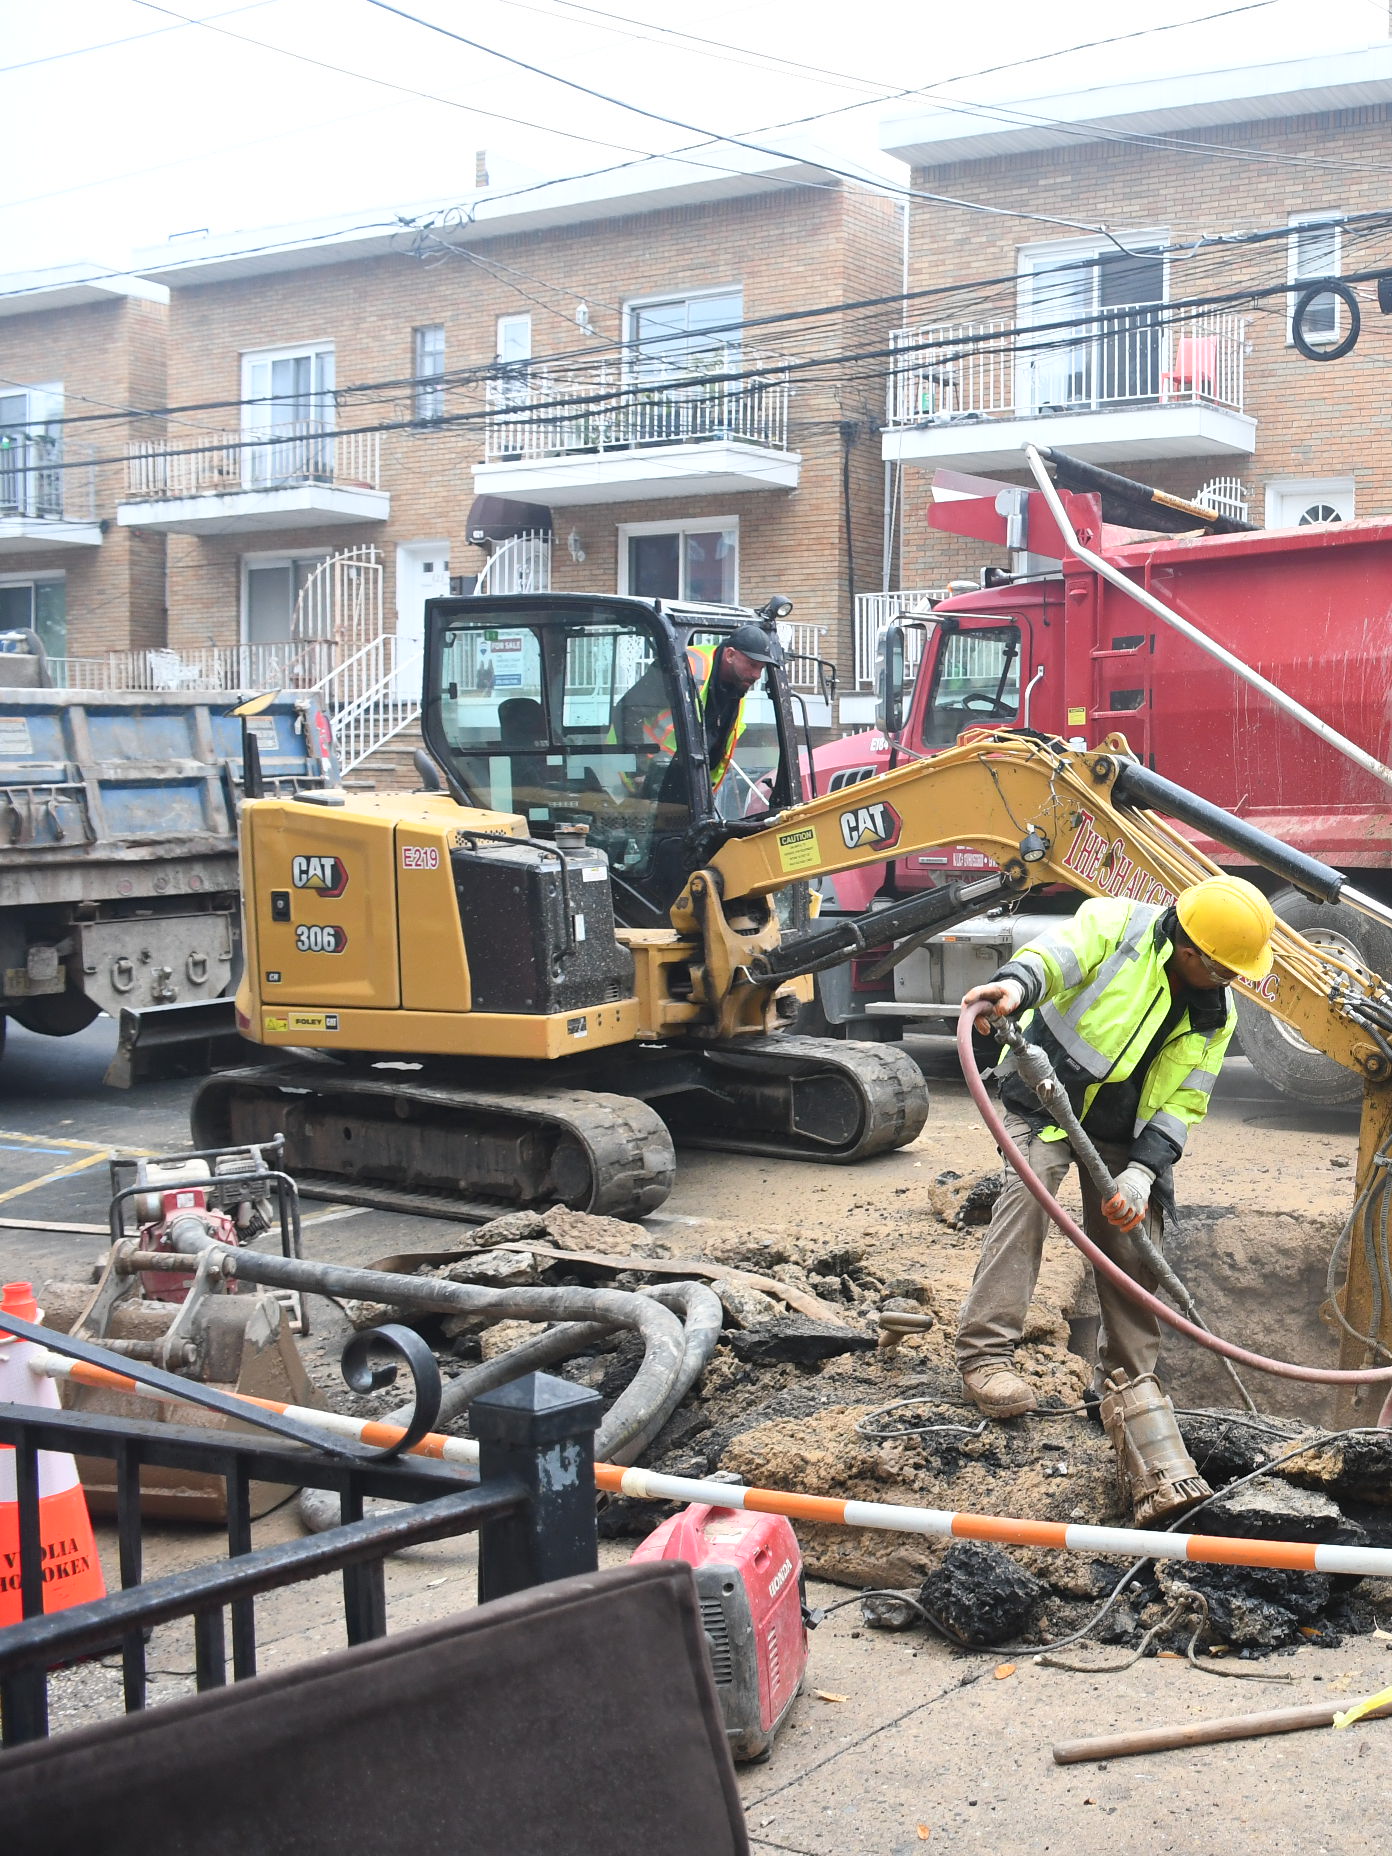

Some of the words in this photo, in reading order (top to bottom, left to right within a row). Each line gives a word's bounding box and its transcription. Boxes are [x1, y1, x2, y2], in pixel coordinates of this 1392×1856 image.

[504, 640, 521, 650] SALE
[781, 831, 813, 845] CAUTION
[840, 803, 885, 848] CAT
[402, 847, 438, 868] E219
[1062, 809, 1109, 882] THE
[292, 856, 335, 888] CAT
[296, 926, 335, 951] 306
[3, 1538, 79, 1569] VOLIA
[0, 1555, 91, 1593] OOKEN
[768, 1558, 793, 1598] HONDA
